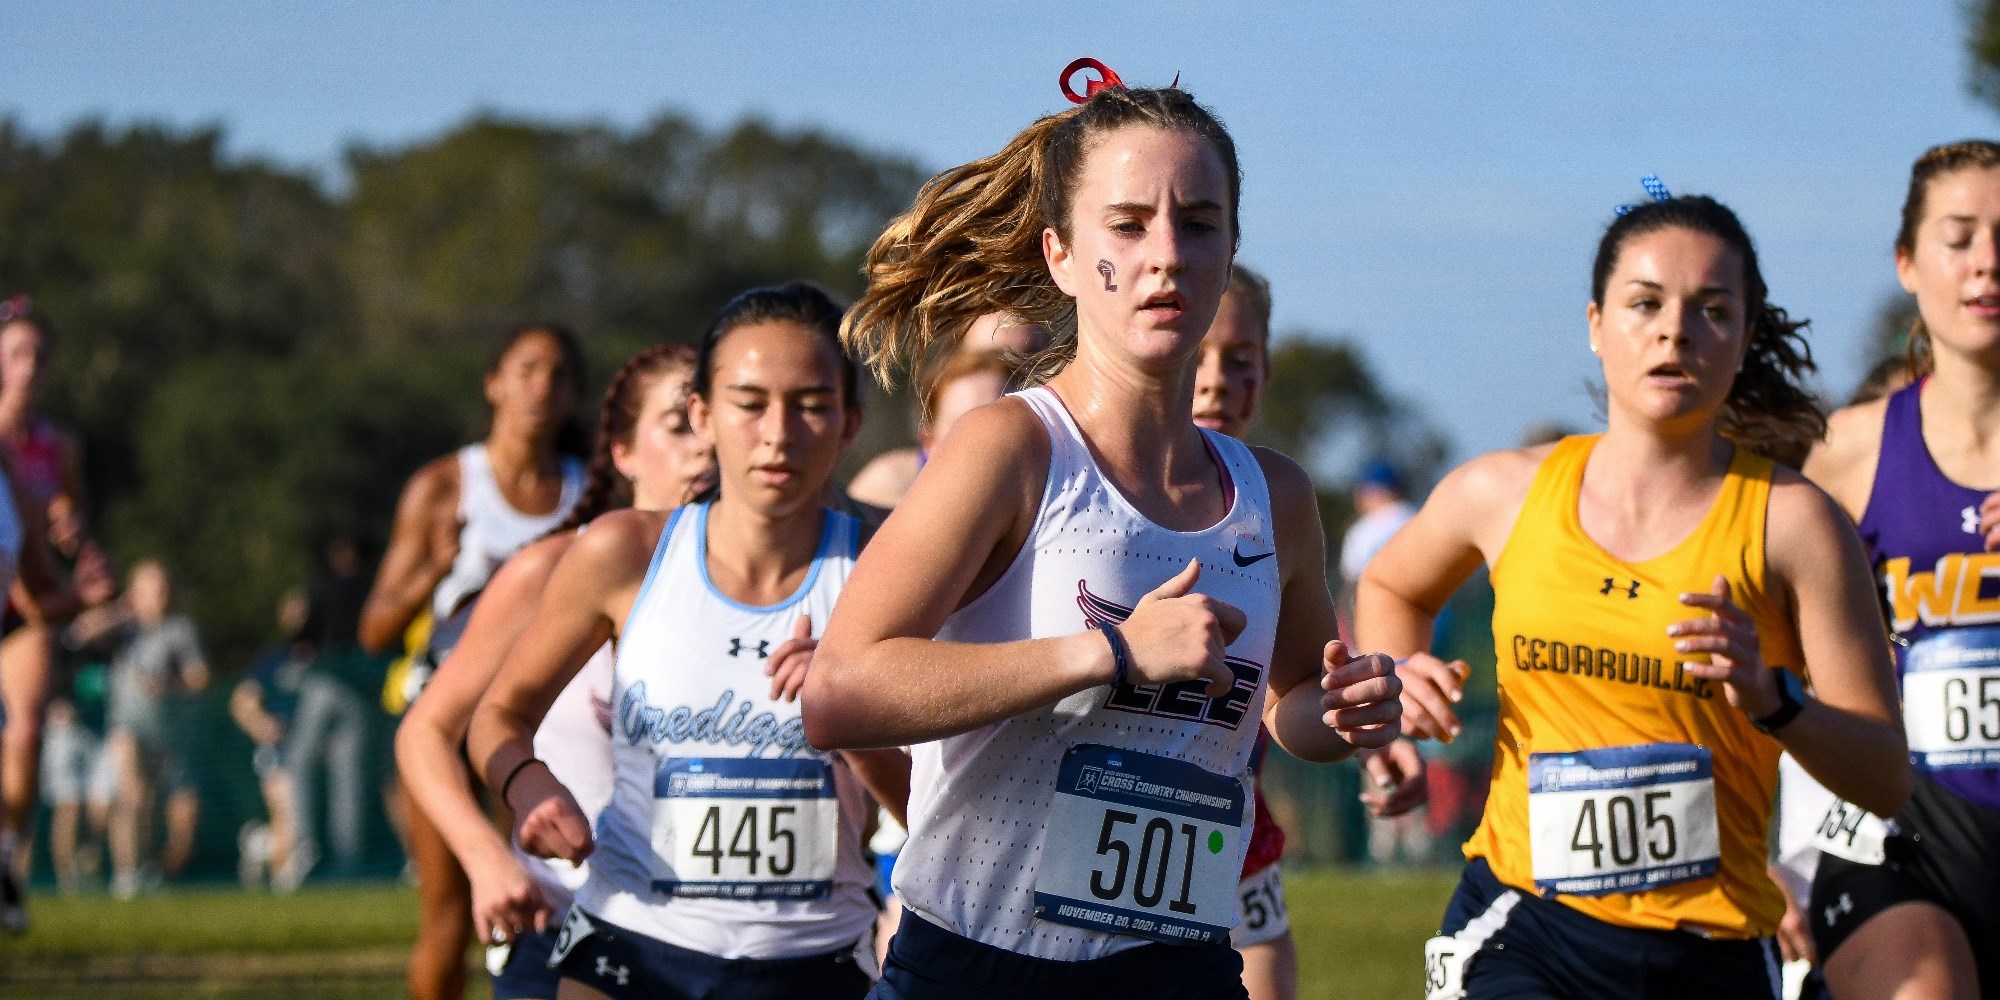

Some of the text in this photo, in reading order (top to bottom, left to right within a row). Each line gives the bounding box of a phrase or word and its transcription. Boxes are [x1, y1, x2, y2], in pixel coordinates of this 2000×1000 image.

[1100, 775, 1135, 791] CROSS
[1135, 781, 1176, 799] COUNTRY
[1175, 788, 1232, 810] CHAMPIONSHIPS
[692, 806, 796, 876] 445
[1090, 808, 1198, 915] 501
[1571, 791, 1677, 868] 405
[1058, 904, 1114, 925] NOVEMBER
[1114, 915, 1130, 929] 20,
[1131, 918, 1154, 932] 2021
[1159, 923, 1186, 938] SAINT
